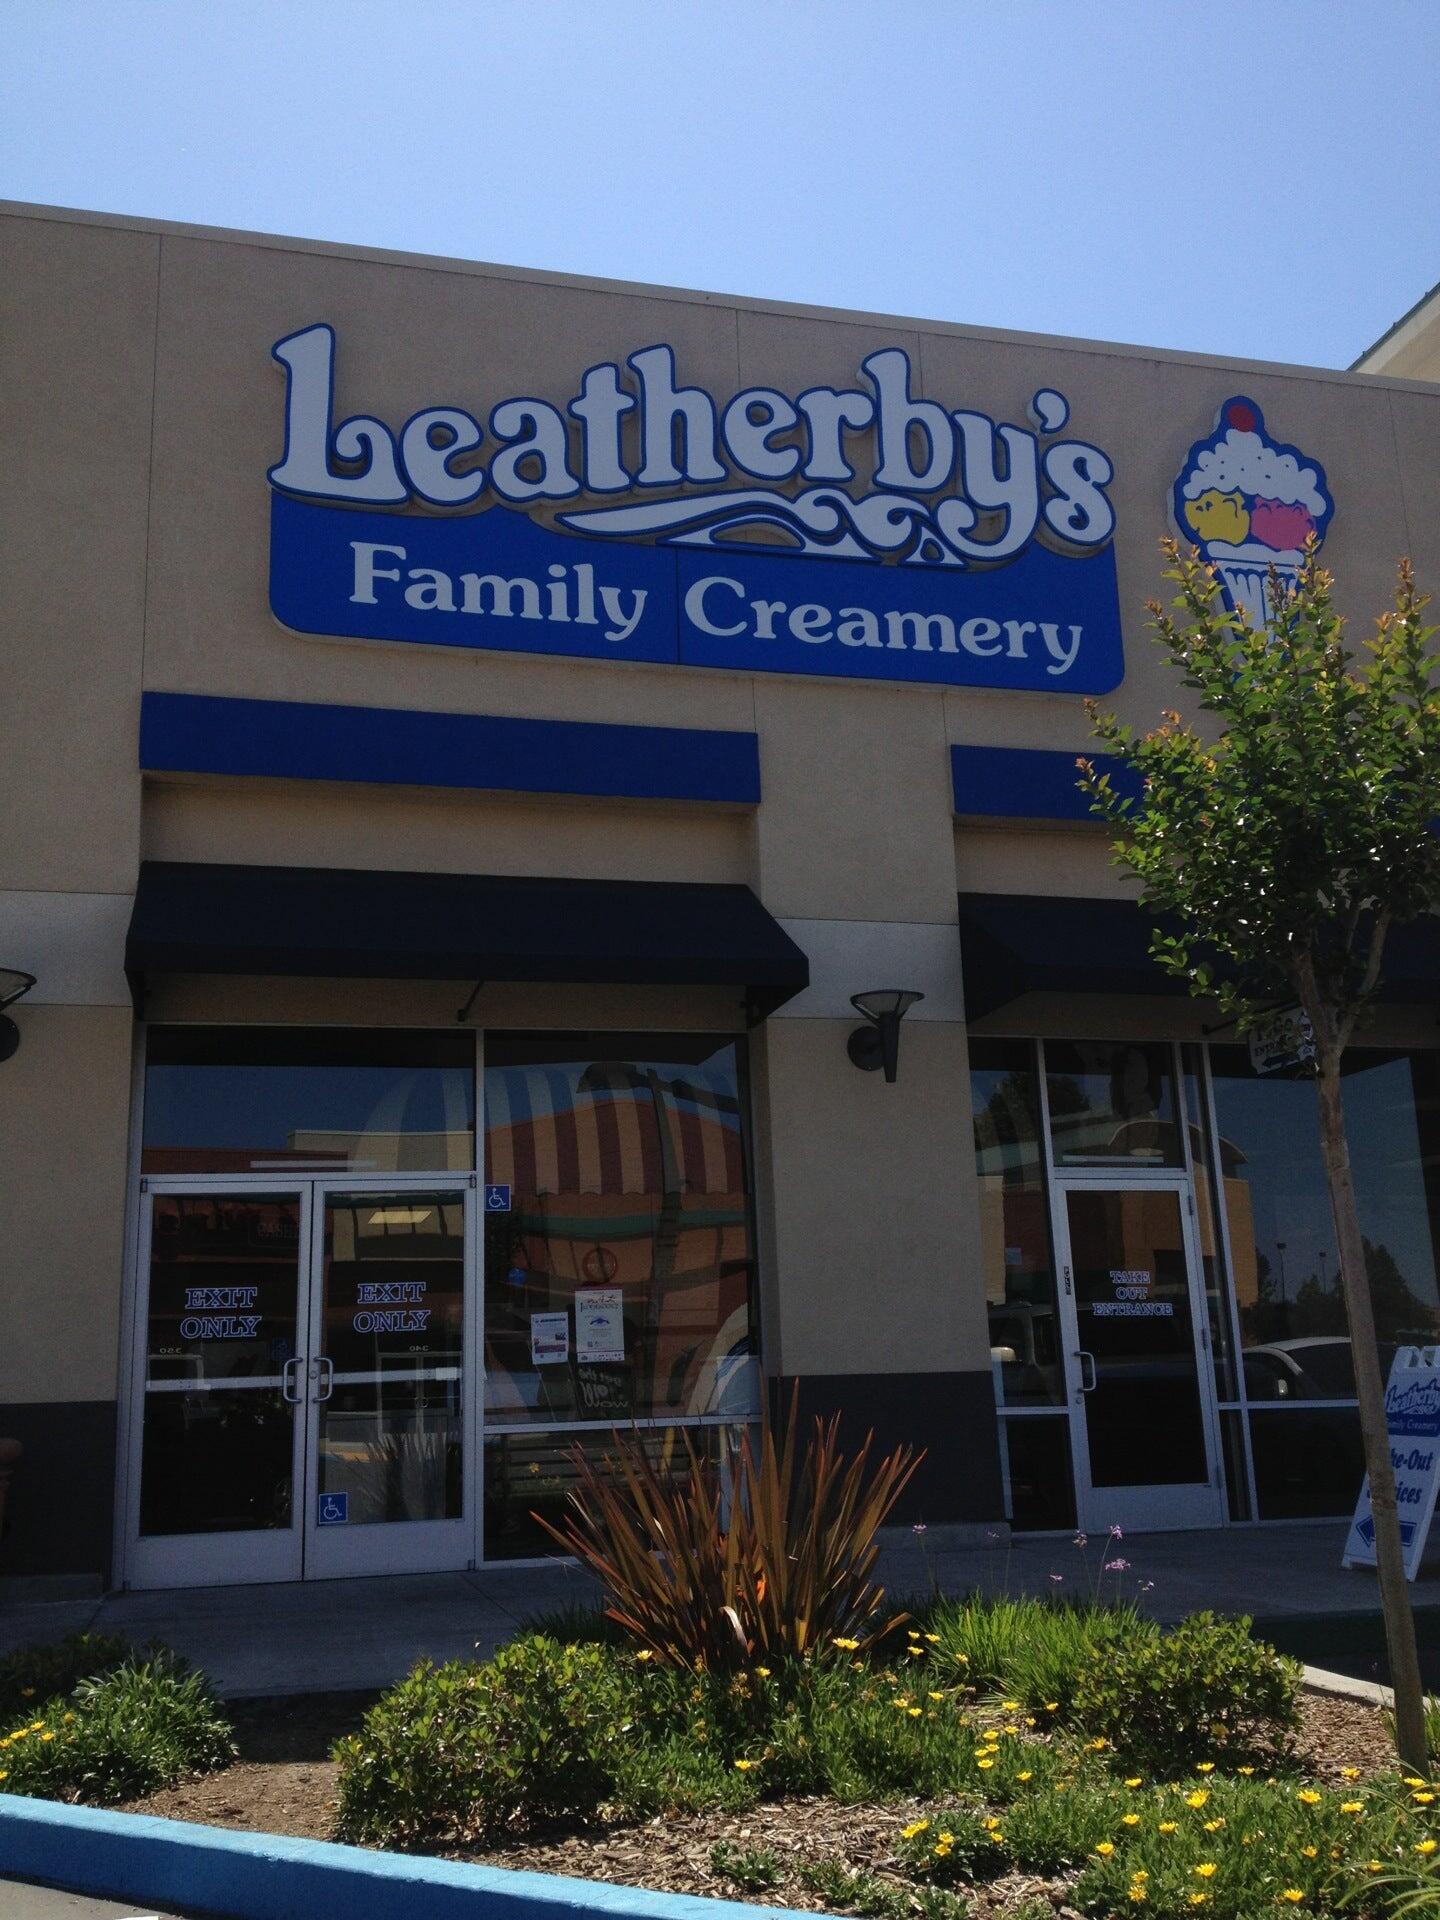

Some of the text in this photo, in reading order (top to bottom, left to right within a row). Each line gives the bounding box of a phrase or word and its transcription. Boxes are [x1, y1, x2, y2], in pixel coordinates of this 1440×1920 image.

[267, 323, 1114, 562] Leatherby's
[349, 541, 1083, 675] Family Creamery
[1110, 1271, 1150, 1283] TAKE
[185, 1287, 258, 1309] EXIT
[357, 1282, 426, 1304] EXIT
[1116, 1287, 1148, 1299] OUT
[1092, 1303, 1173, 1315] ENTRANCE
[180, 1316, 262, 1338] ONLY
[353, 1310, 431, 1333] ONLY
